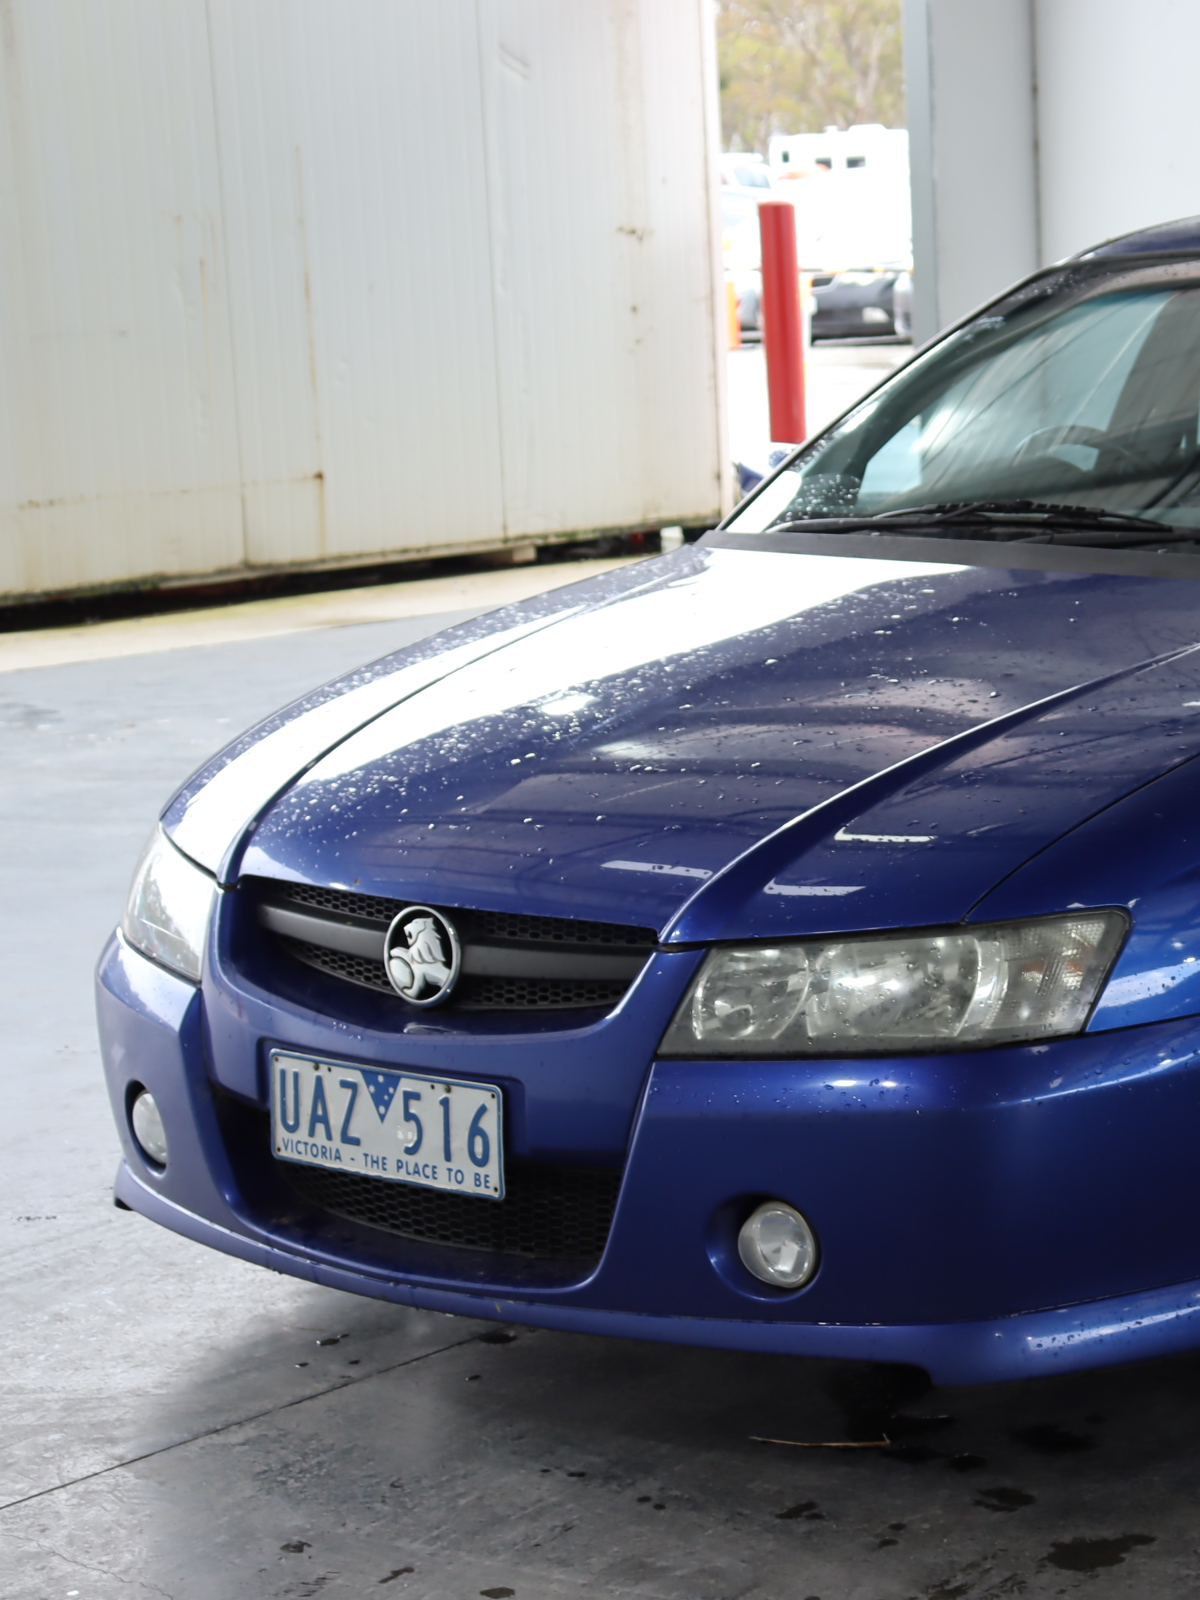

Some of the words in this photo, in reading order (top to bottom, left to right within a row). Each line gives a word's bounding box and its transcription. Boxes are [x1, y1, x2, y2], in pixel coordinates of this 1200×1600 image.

[279, 1068, 361, 1146] UAZ
[402, 1090, 491, 1168] 516
[281, 1137, 343, 1163] VICTORIA
[362, 1153, 388, 1172] THE
[396, 1159, 438, 1181] PLACE
[446, 1167, 465, 1185] TO
[473, 1173, 491, 1190] BE
